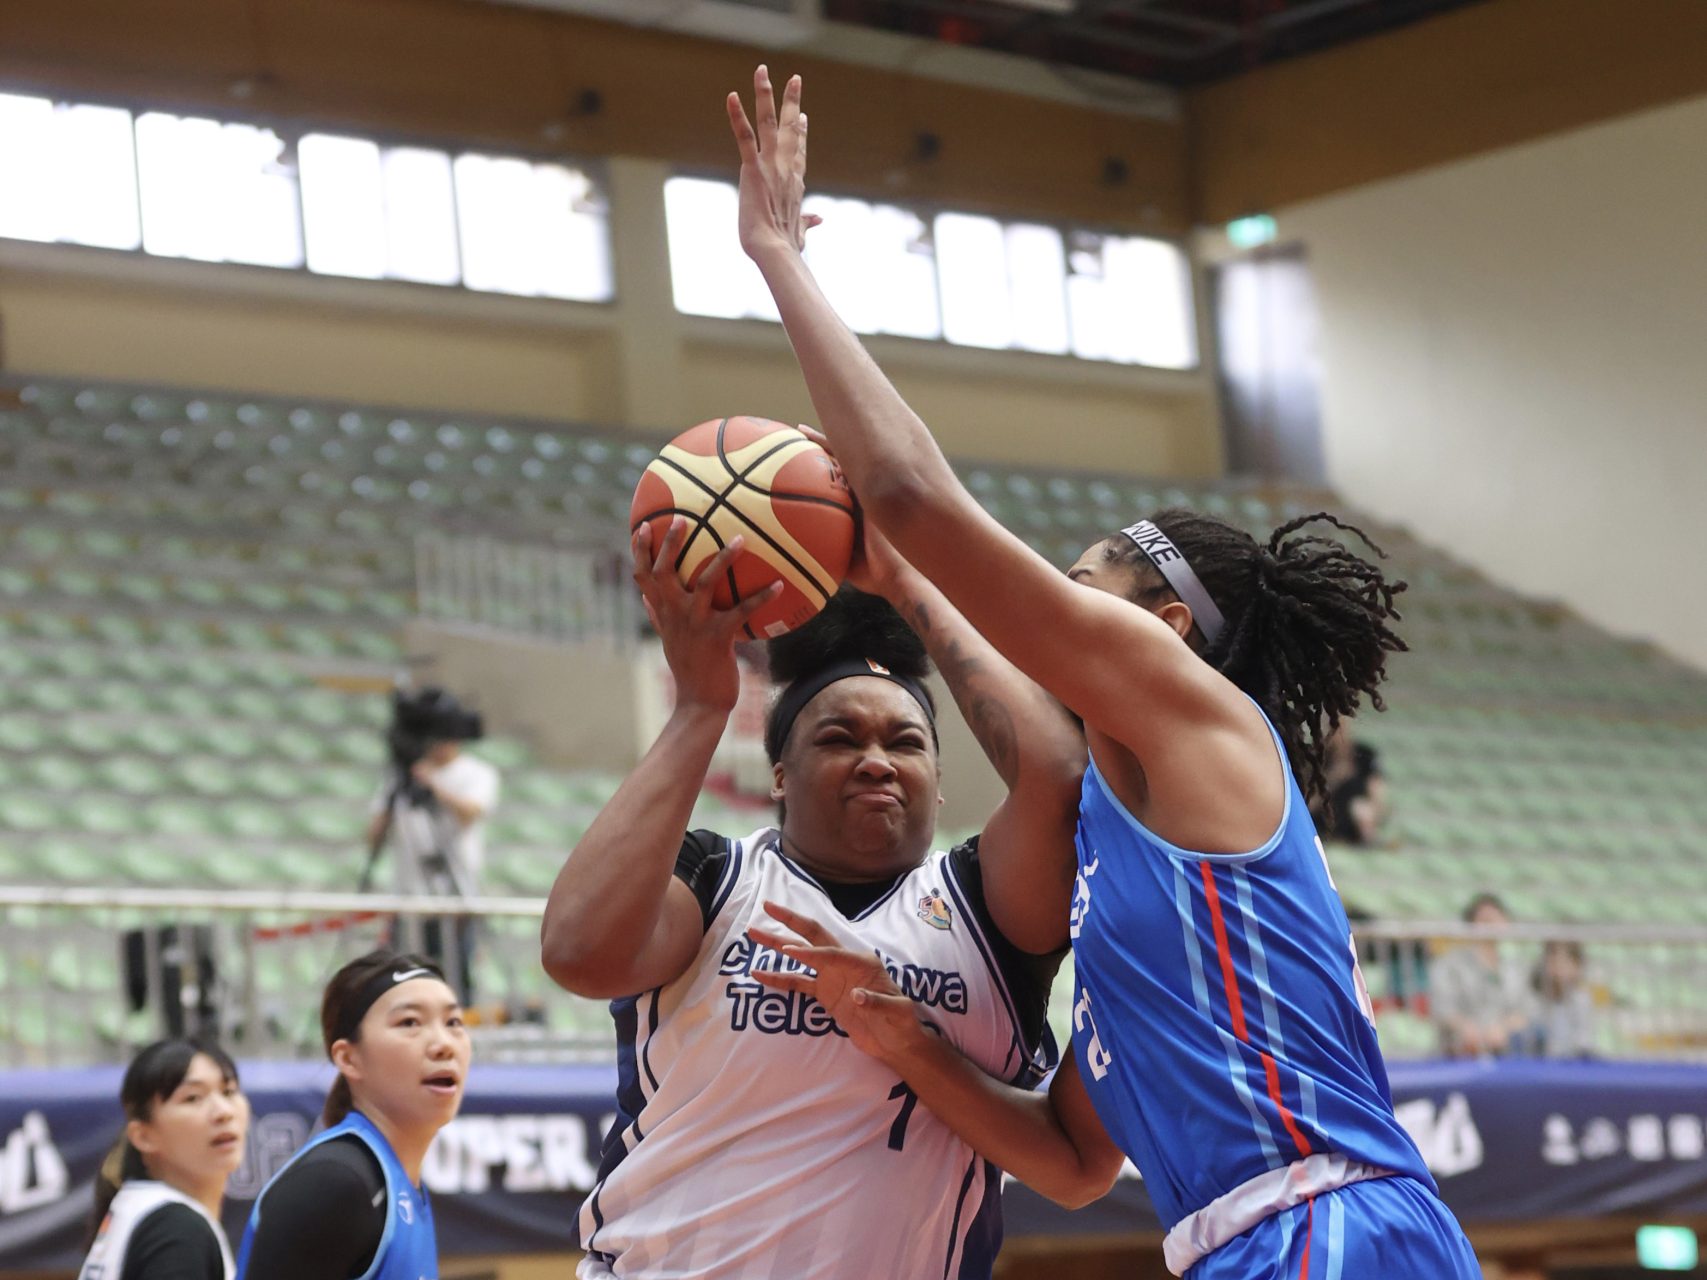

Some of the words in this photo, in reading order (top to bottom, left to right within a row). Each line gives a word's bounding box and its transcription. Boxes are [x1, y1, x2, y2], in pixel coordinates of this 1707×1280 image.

[1131, 525, 1181, 565] NIKE
[718, 932, 968, 1015] Chuhwa
[420, 1113, 598, 1194] UPER
